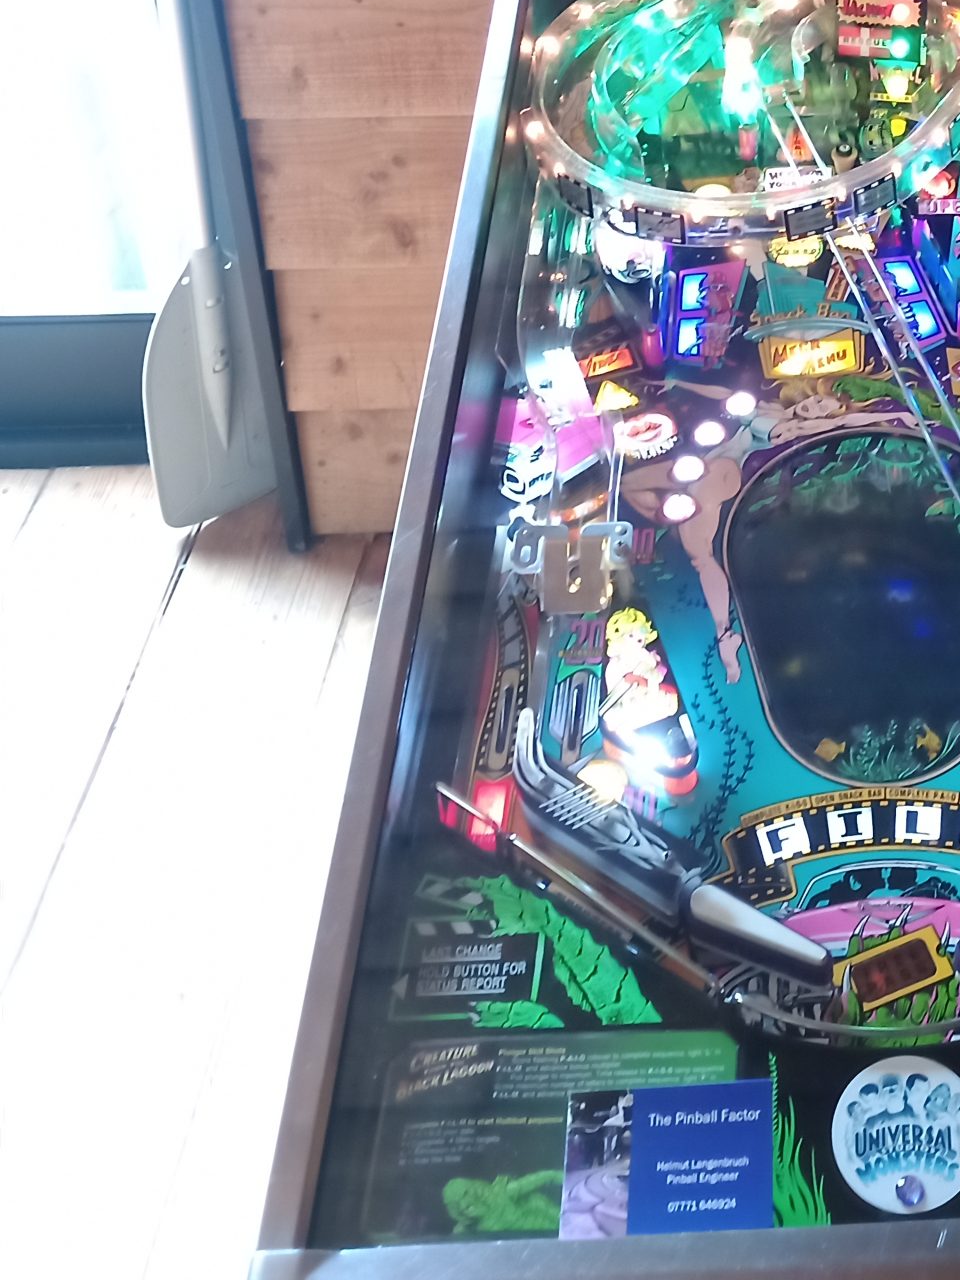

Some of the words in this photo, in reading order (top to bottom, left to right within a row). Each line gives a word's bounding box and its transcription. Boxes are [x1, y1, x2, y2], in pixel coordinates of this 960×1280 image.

[455, 943, 503, 956] CHANGE
[453, 962, 500, 978] BUTTON
[502, 960, 527, 975] FOR
[461, 976, 508, 991] REPORT
[410, 1044, 479, 1071] CREATURE
[442, 1060, 495, 1086] LAGOON
[648, 1113, 671, 1127] The
[675, 1109, 718, 1125] Pinball
[721, 1108, 761, 1122] Factor
[854, 1123, 953, 1158] UNIVERSAL
[656, 1159, 690, 1172] Helmut
[666, 1173, 697, 1185] Pinball
[699, 1172, 739, 1185] Engineer
[667, 1200, 697, 1213] 07771
